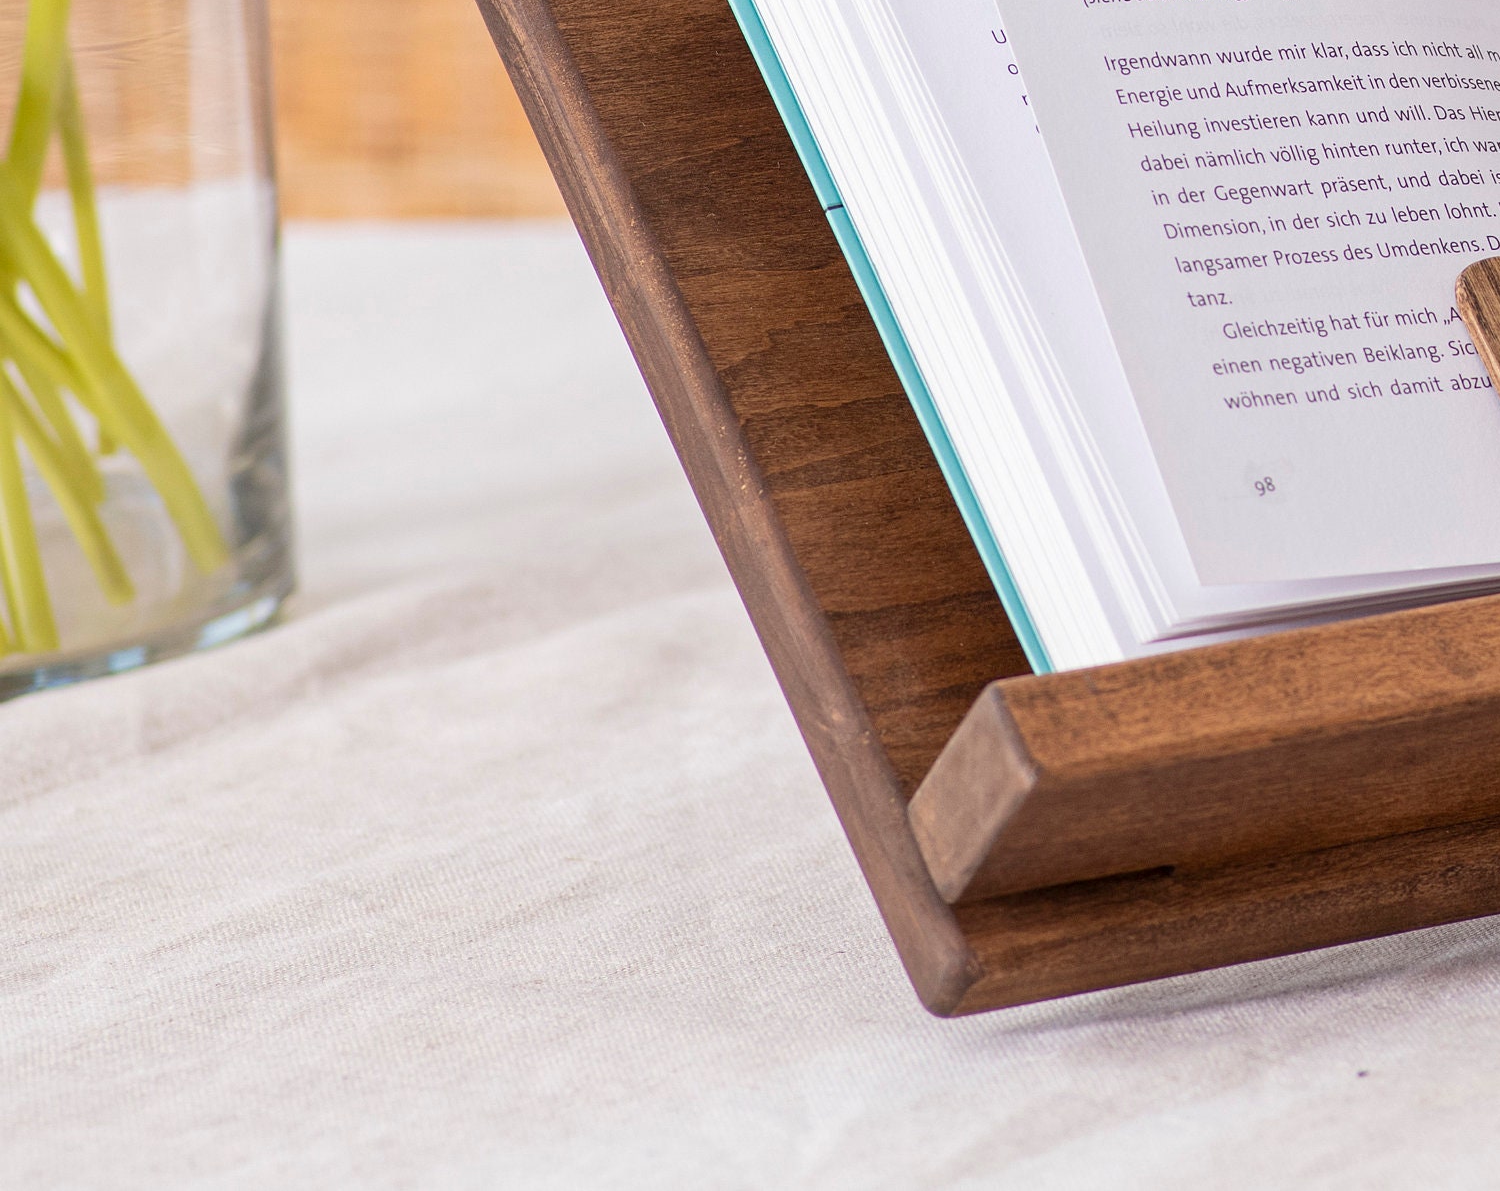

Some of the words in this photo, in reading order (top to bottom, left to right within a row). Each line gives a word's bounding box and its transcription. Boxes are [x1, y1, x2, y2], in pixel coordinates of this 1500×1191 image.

[1104, 51, 1211, 75] Irgendwann
[1216, 45, 1273, 64] wurde
[1278, 44, 1306, 60] mir
[1311, 42, 1348, 60] klar,
[1352, 41, 1389, 57] dass
[1392, 40, 1418, 56] ich
[1422, 42, 1463, 58] nicht
[1466, 44, 1484, 60] all
[1151, 190, 1170, 205] in
[1178, 187, 1205, 204] der
[1214, 179, 1314, 204] Gegenwart
[1321, 174, 1391, 199] präsent,
[1397, 171, 1431, 188] und
[1439, 169, 1485, 186] dabei
[1174, 255, 1267, 276] langsamer
[1273, 250, 1338, 266] Prozess
[1343, 244, 1373, 260] des
[1376, 237, 1484, 258] Umdenkens.
[1187, 292, 1232, 307] tanz.
[1224, 391, 1298, 409] wöhnen
[1305, 384, 1340, 403] und
[1348, 381, 1383, 399] sich
[1390, 377, 1443, 395] damit
[1254, 476, 1276, 497] 98
